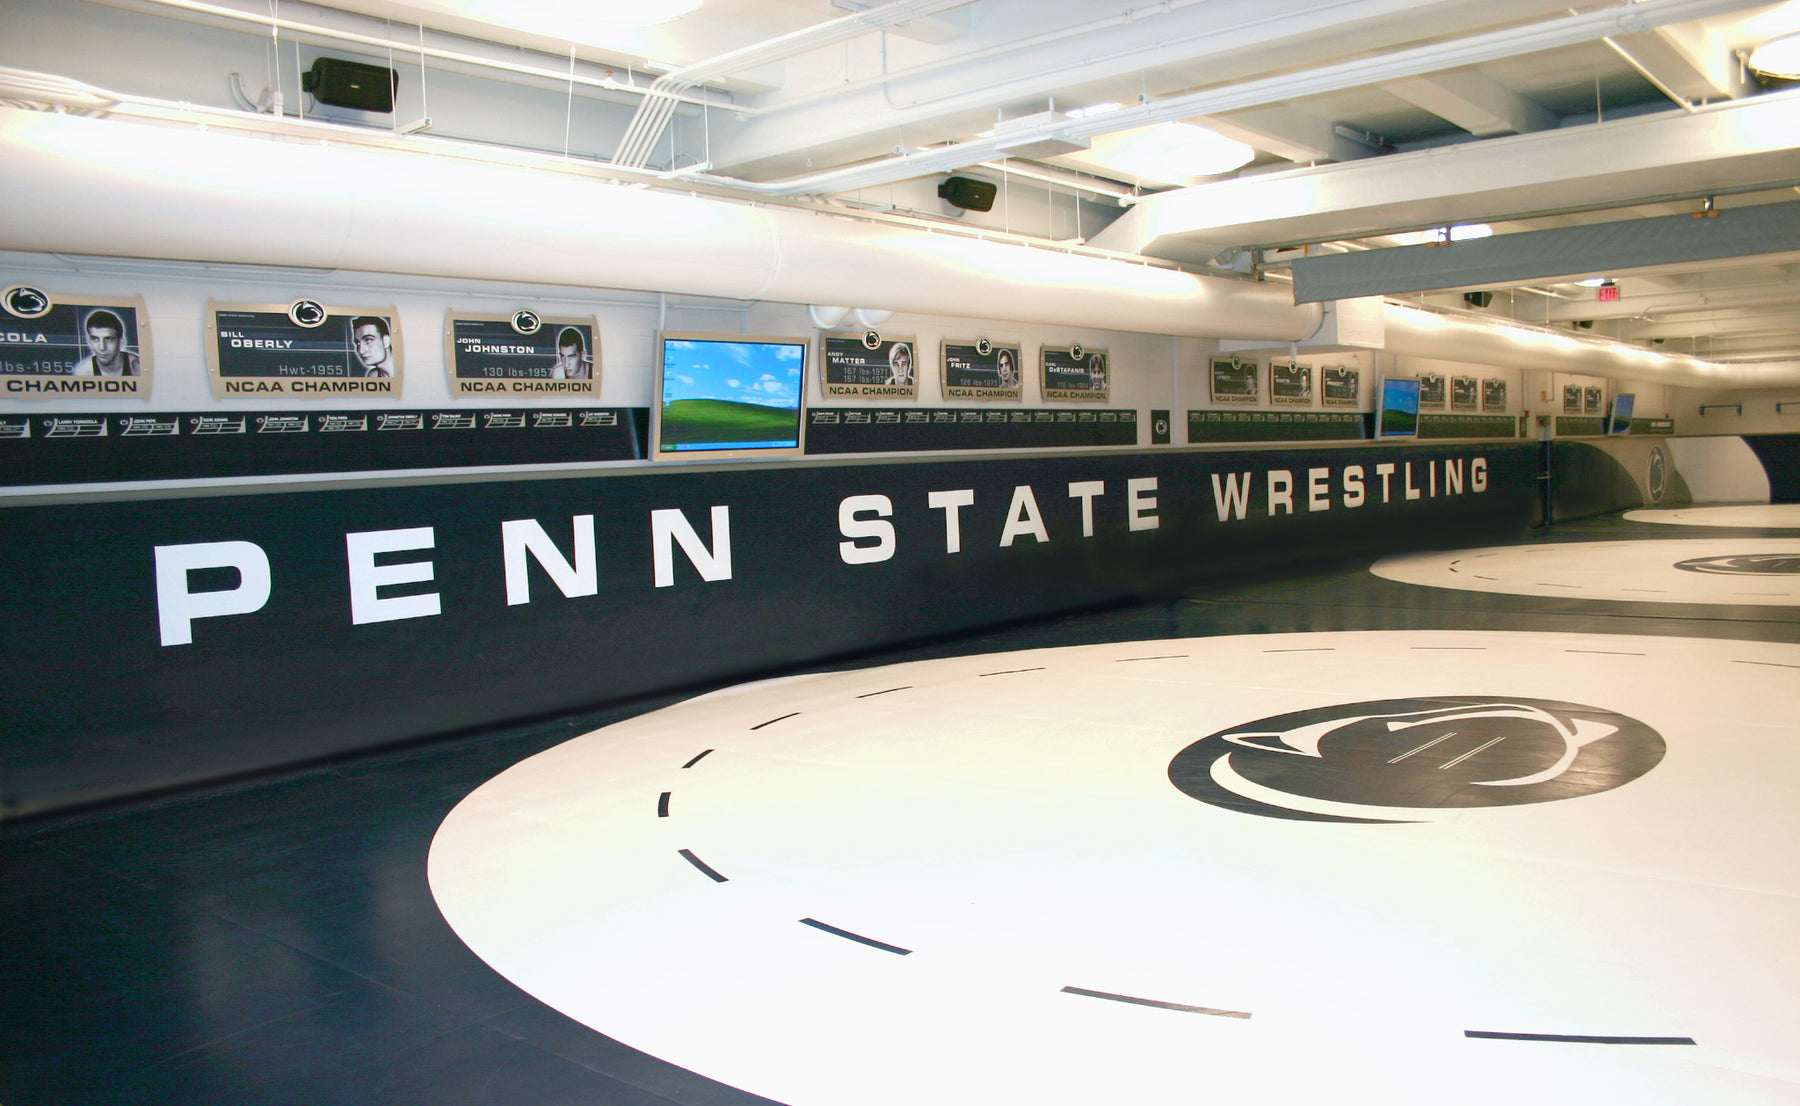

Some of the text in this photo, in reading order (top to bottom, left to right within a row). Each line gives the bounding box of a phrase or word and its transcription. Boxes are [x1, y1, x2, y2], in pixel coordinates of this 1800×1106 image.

[1599, 287, 1618, 301] EXIT
[231, 339, 293, 349] OBERLY
[465, 344, 535, 354] JOHNSTON
[832, 357, 866, 365] MATTER
[279, 364, 343, 375] Hwt-1955
[483, 367, 504, 377] 130
[7, 380, 137, 392] CHAMPION
[225, 381, 391, 393] NCAA CHAMPION
[461, 382, 592, 392] NCAA CHAMPION
[829, 387, 913, 396] NCAA CHAMPION
[948, 389, 1018, 398] NCAA CHAMPION
[1047, 391, 1106, 400] NCAA CHAMPION
[153, 456, 1489, 647] PENN STATE WRESTLING
